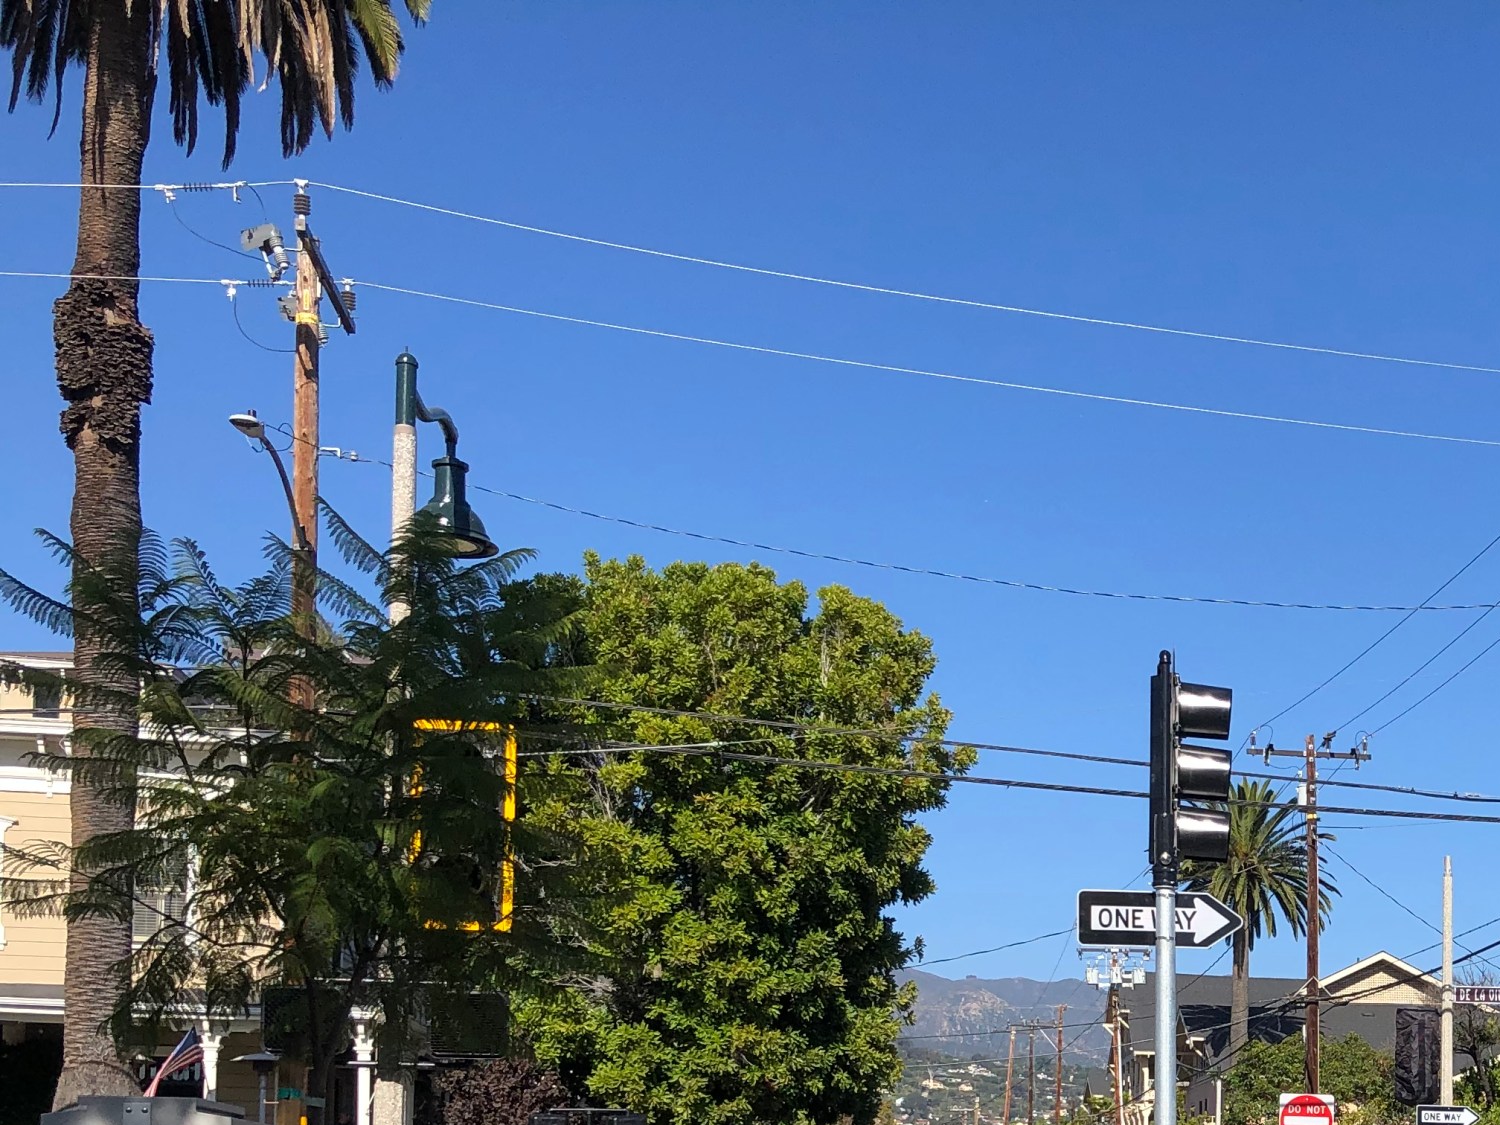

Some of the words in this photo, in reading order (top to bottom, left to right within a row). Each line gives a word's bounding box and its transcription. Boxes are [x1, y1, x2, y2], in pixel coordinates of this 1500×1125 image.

[1098, 908, 1144, 928] ONE
[1151, 909, 1197, 930] AY
[1460, 988, 1471, 1001] DE
[1474, 989, 1485, 1002] LA
[1288, 1105, 1301, 1114] DO
[1306, 1105, 1326, 1114] NOT
[1424, 1113, 1441, 1121] ONE
[1444, 1113, 1462, 1122] WAY
